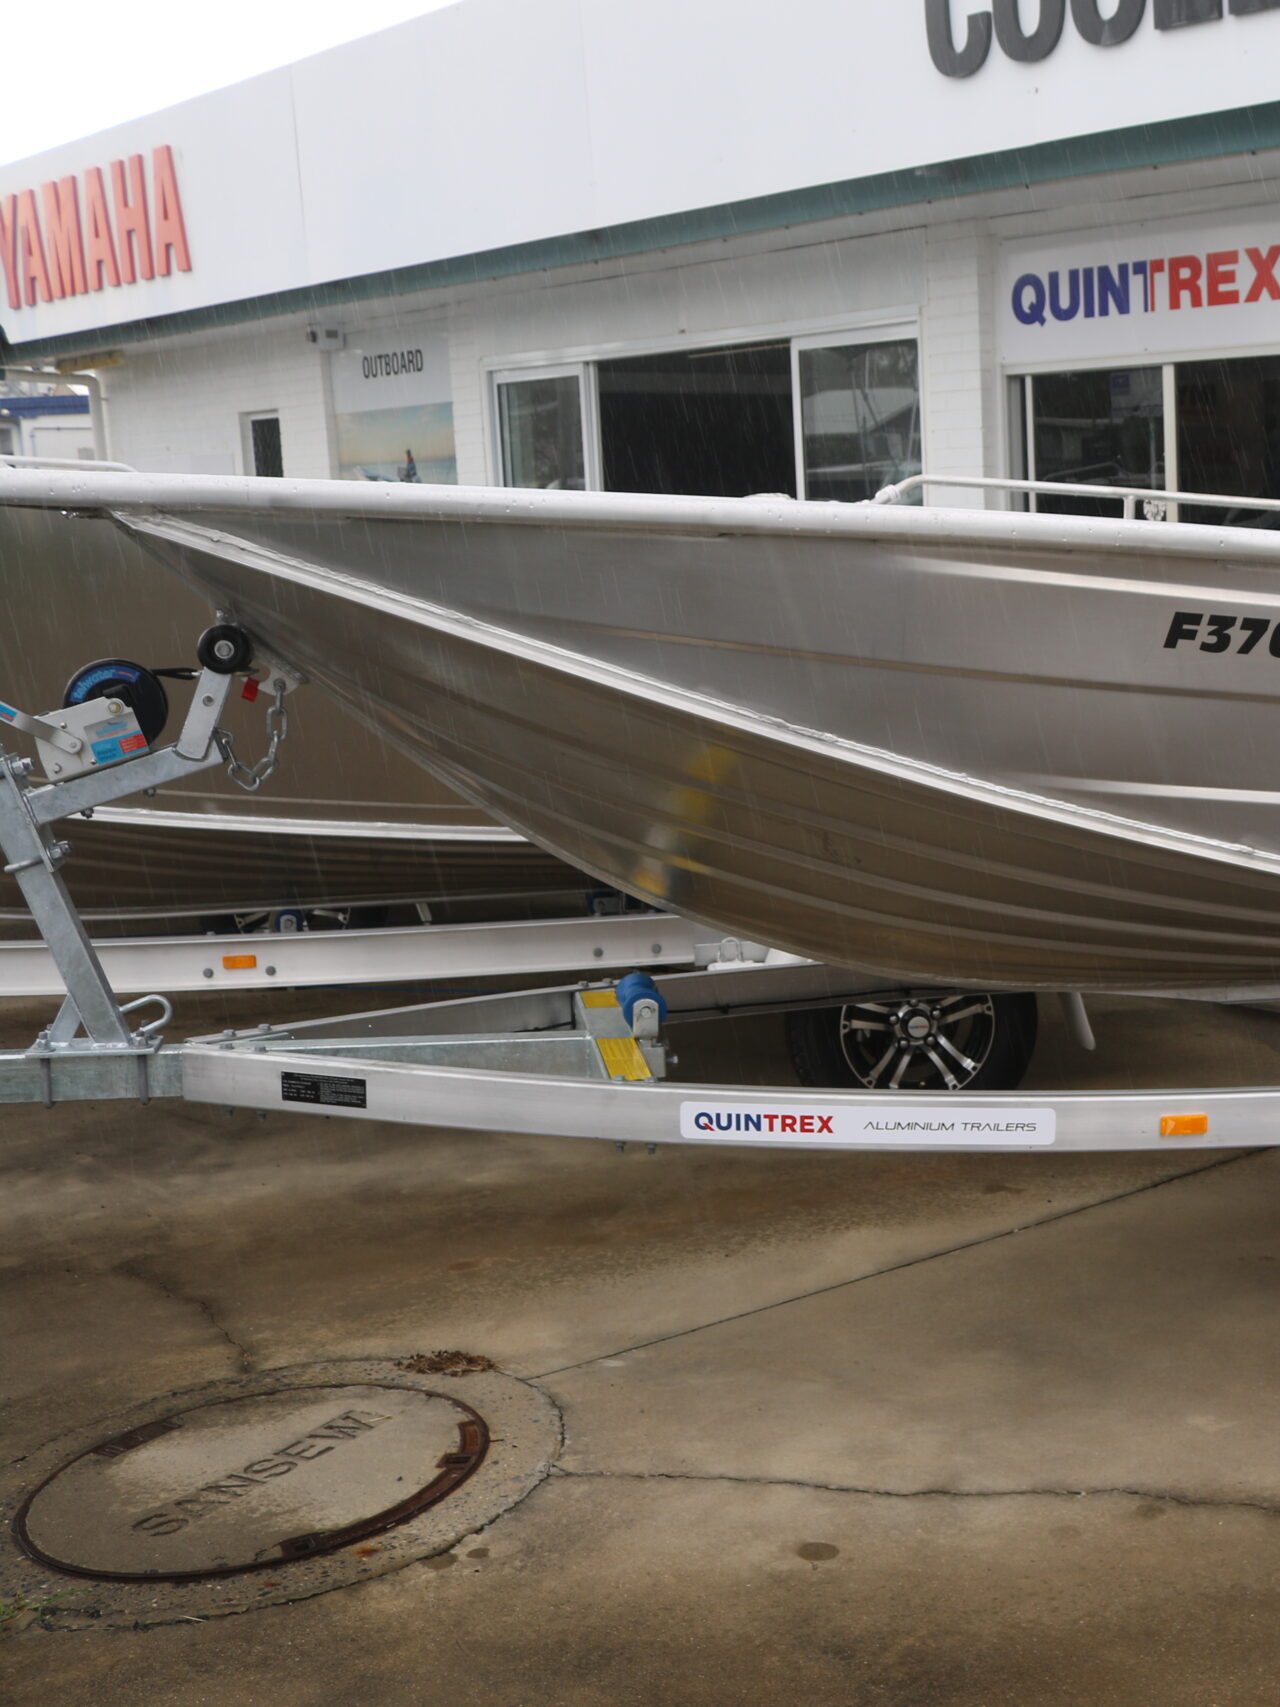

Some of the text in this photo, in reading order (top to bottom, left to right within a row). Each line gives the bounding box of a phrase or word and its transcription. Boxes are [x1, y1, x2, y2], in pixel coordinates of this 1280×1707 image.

[0, 144, 192, 310] YAMAHA
[362, 349, 424, 379] OUTBOARD
[694, 1111, 1037, 1134] QUINTREX ALUMINIUM TRAILERS
